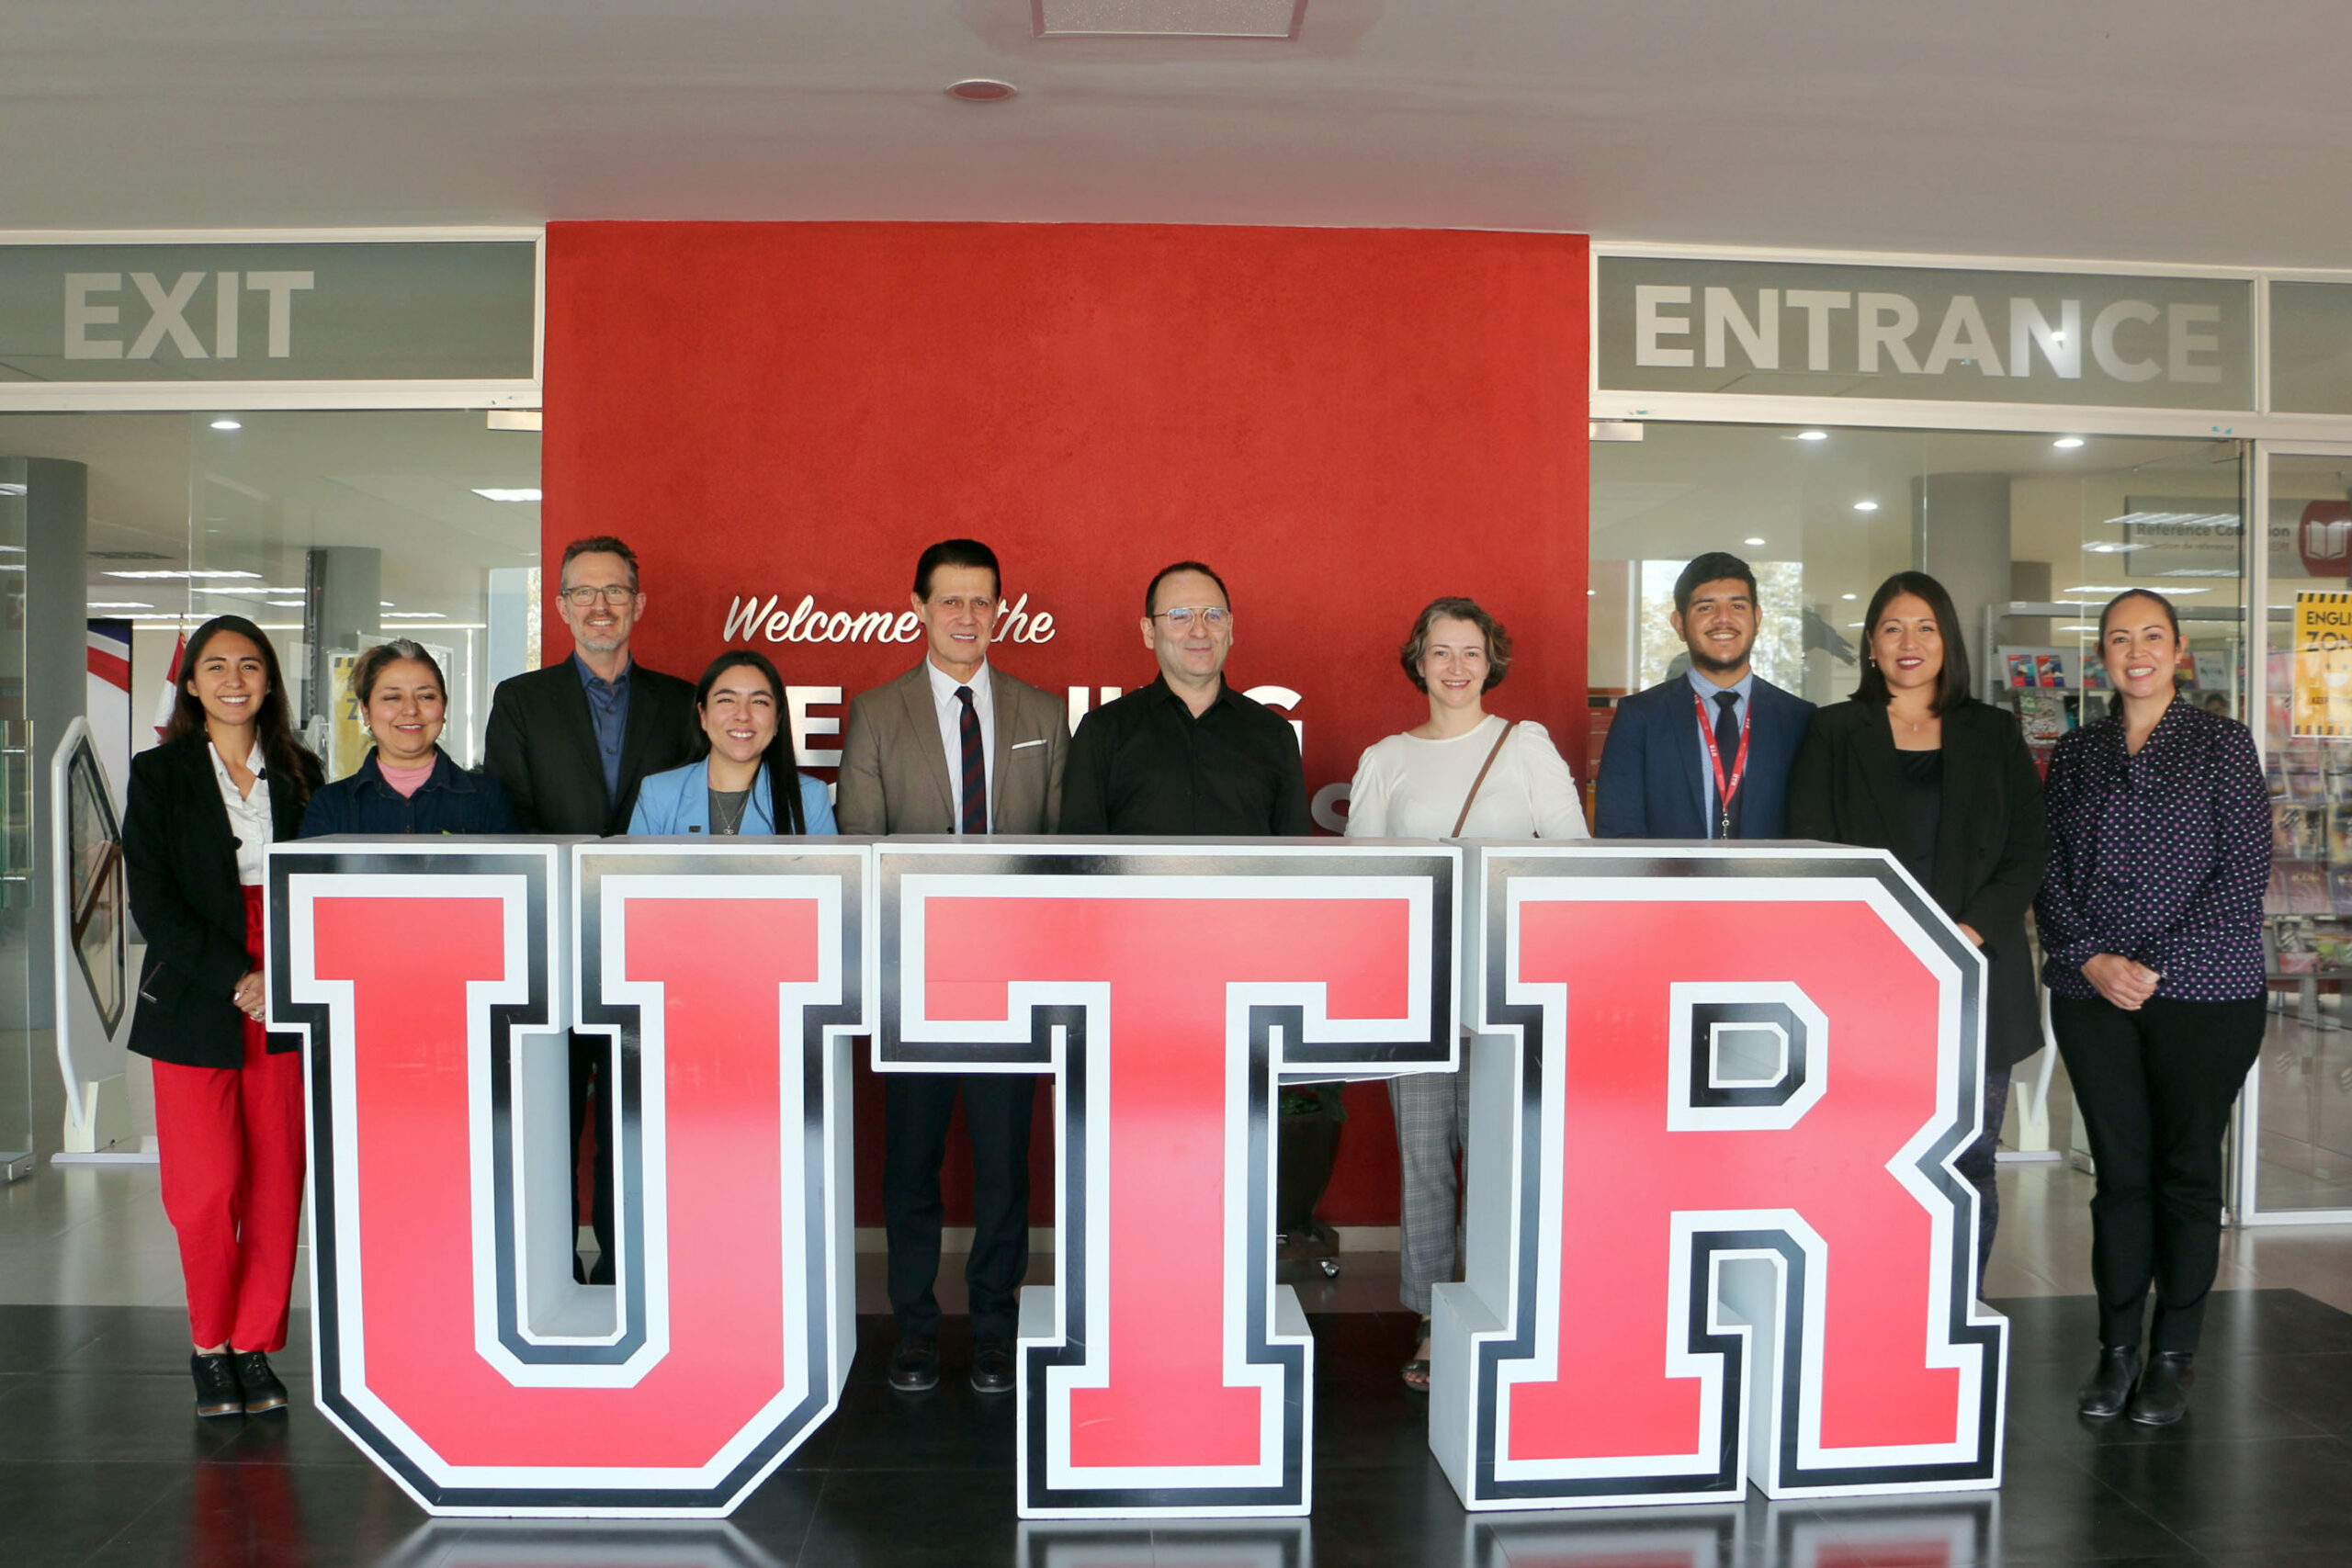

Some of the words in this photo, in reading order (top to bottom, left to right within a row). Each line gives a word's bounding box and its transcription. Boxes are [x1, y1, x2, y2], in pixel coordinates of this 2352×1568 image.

[63, 270, 315, 360] EXIT
[1635, 285, 2222, 383] ENTRANCE
[2137, 524, 2211, 537] Reference
[723, 593, 922, 643] Welcome
[989, 592, 1057, 644] the
[2306, 611, 2352, 626] ENGLI
[264, 842, 2009, 1519] UTR
